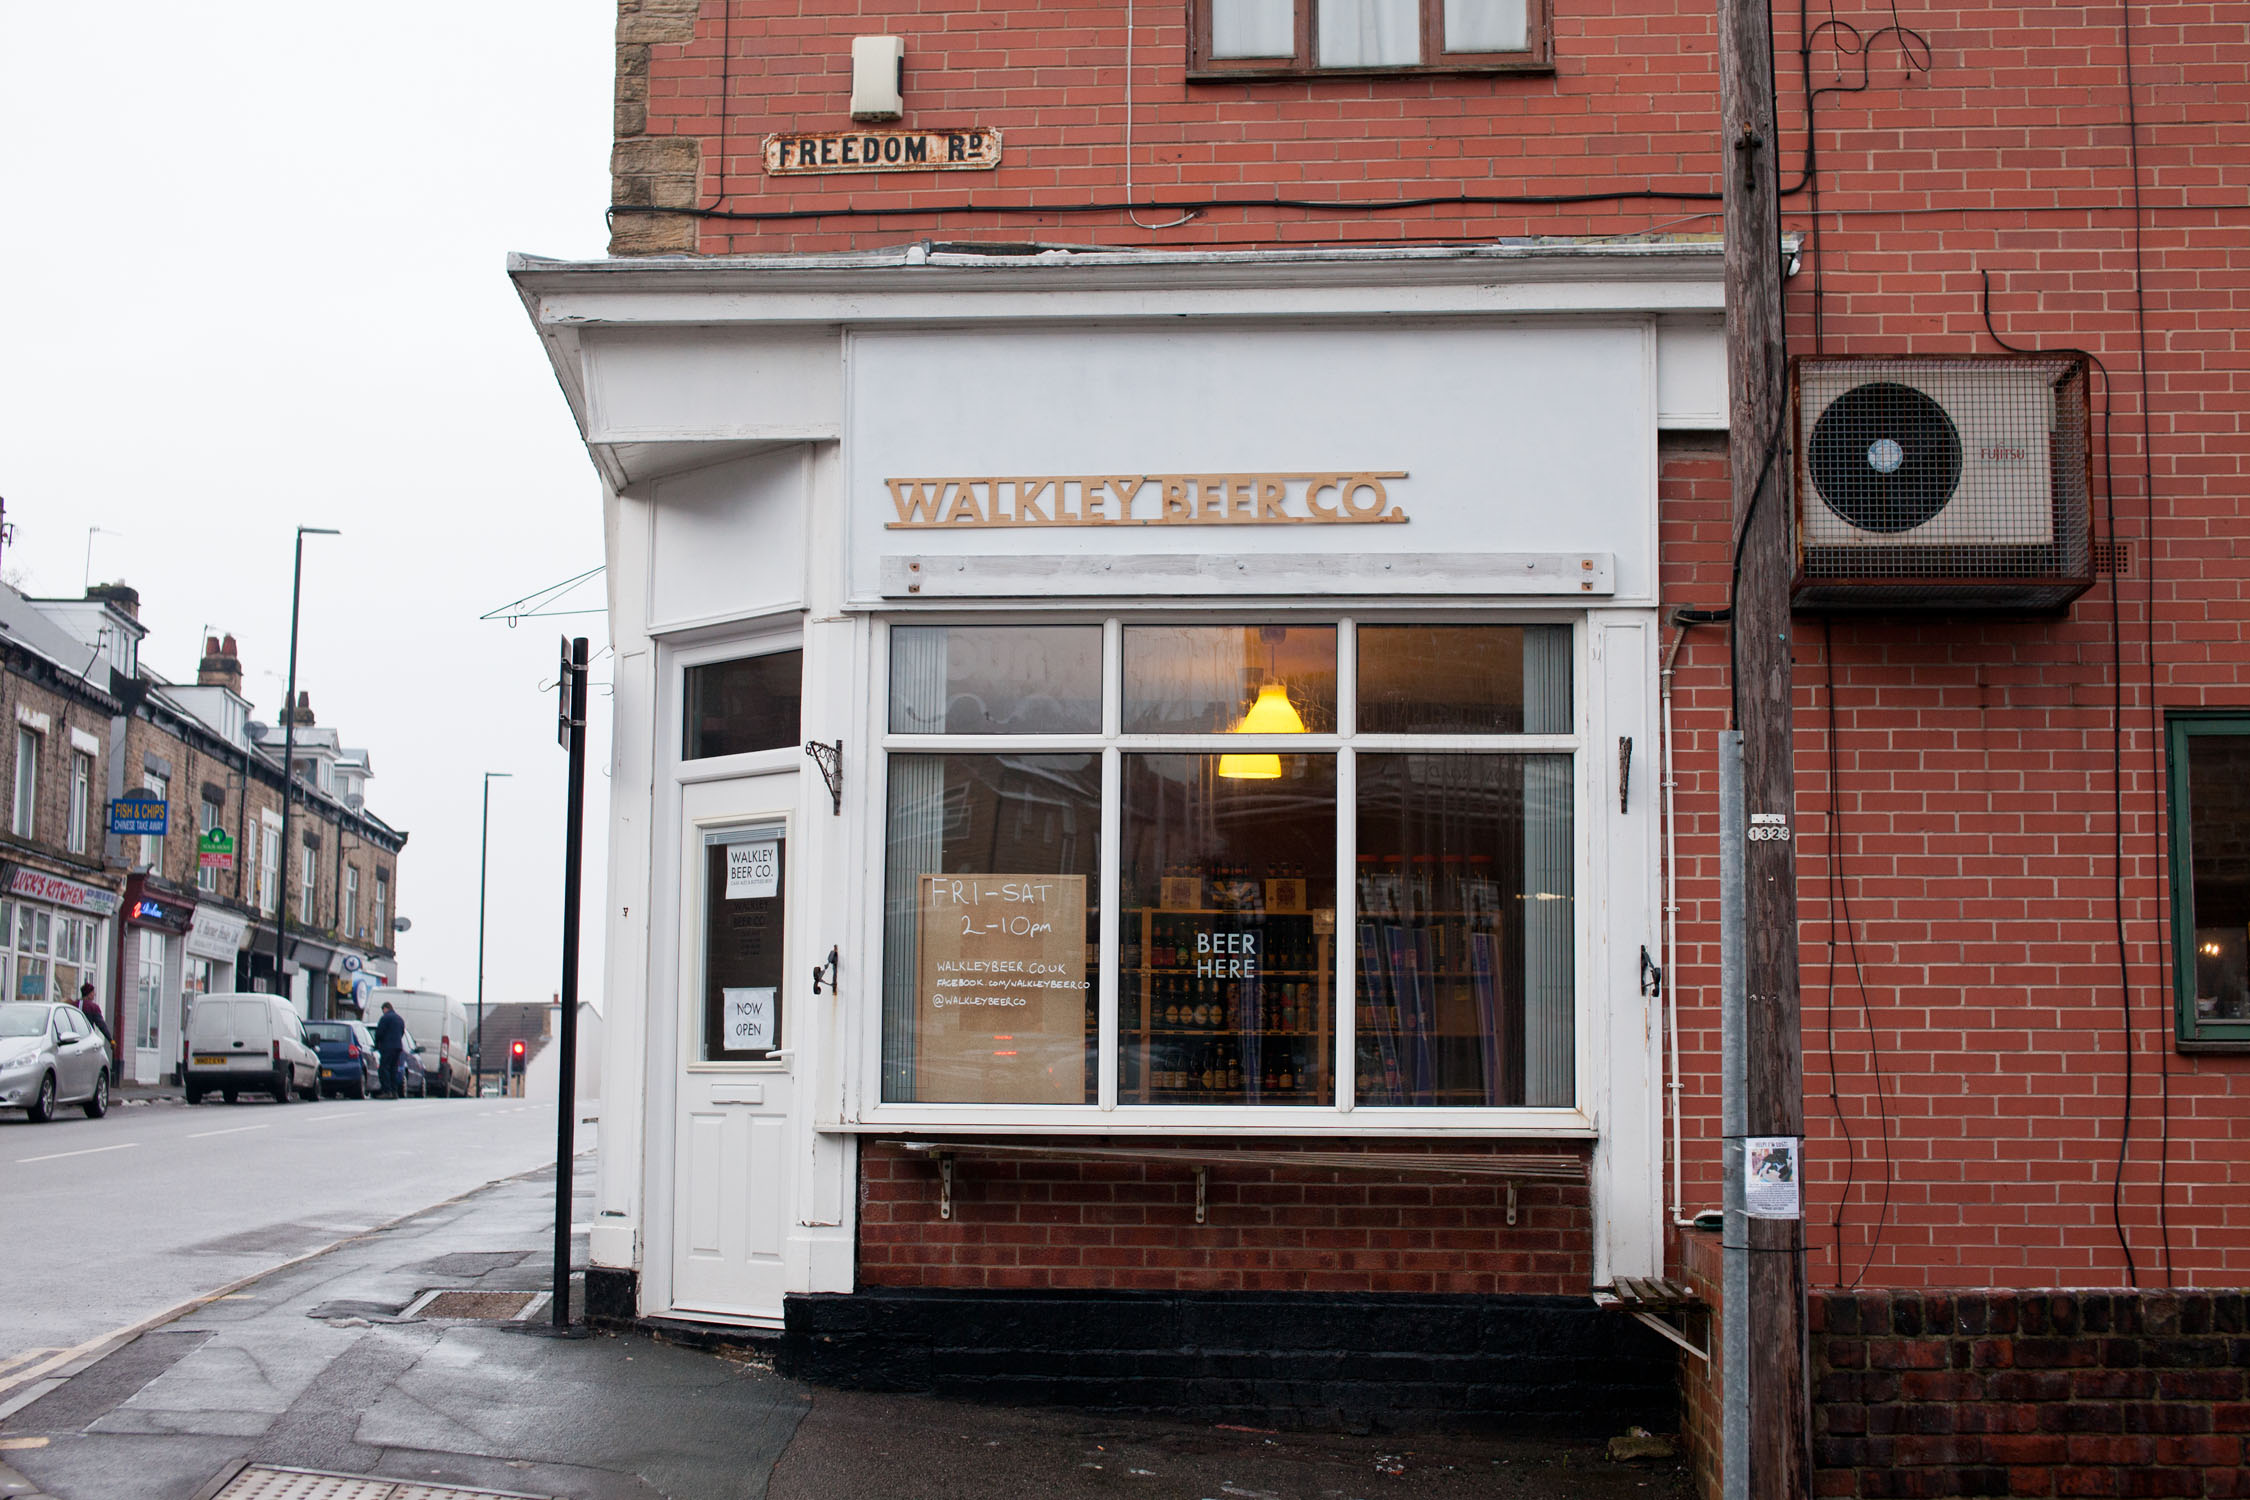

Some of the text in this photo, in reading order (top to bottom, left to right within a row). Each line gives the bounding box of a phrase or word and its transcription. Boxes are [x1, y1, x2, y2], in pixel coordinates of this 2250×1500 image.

[778, 136, 928, 167] FREEDOM
[1980, 447, 2025, 462] FUJITSU
[887, 474, 1408, 525] WALKLEY BEER CO.
[115, 802, 165, 820] FISH & CHIPS
[114, 819, 164, 831] CHINESE TAKE AWAY
[1751, 828, 1788, 839] 1325
[731, 849, 774, 864] WALKLEY
[731, 864, 774, 880] BEER CO.
[12, 869, 47, 896] LUCK'S
[45, 879, 87, 905] KITCHEN
[931, 877, 1053, 907] FRI-SAT
[1197, 932, 1256, 955] BEER
[1196, 959, 1256, 979] HERE
[932, 993, 1027, 1008] @WALKLEYBEERCO
[736, 1002, 763, 1016] NOW
[736, 1022, 762, 1036] OPEN
